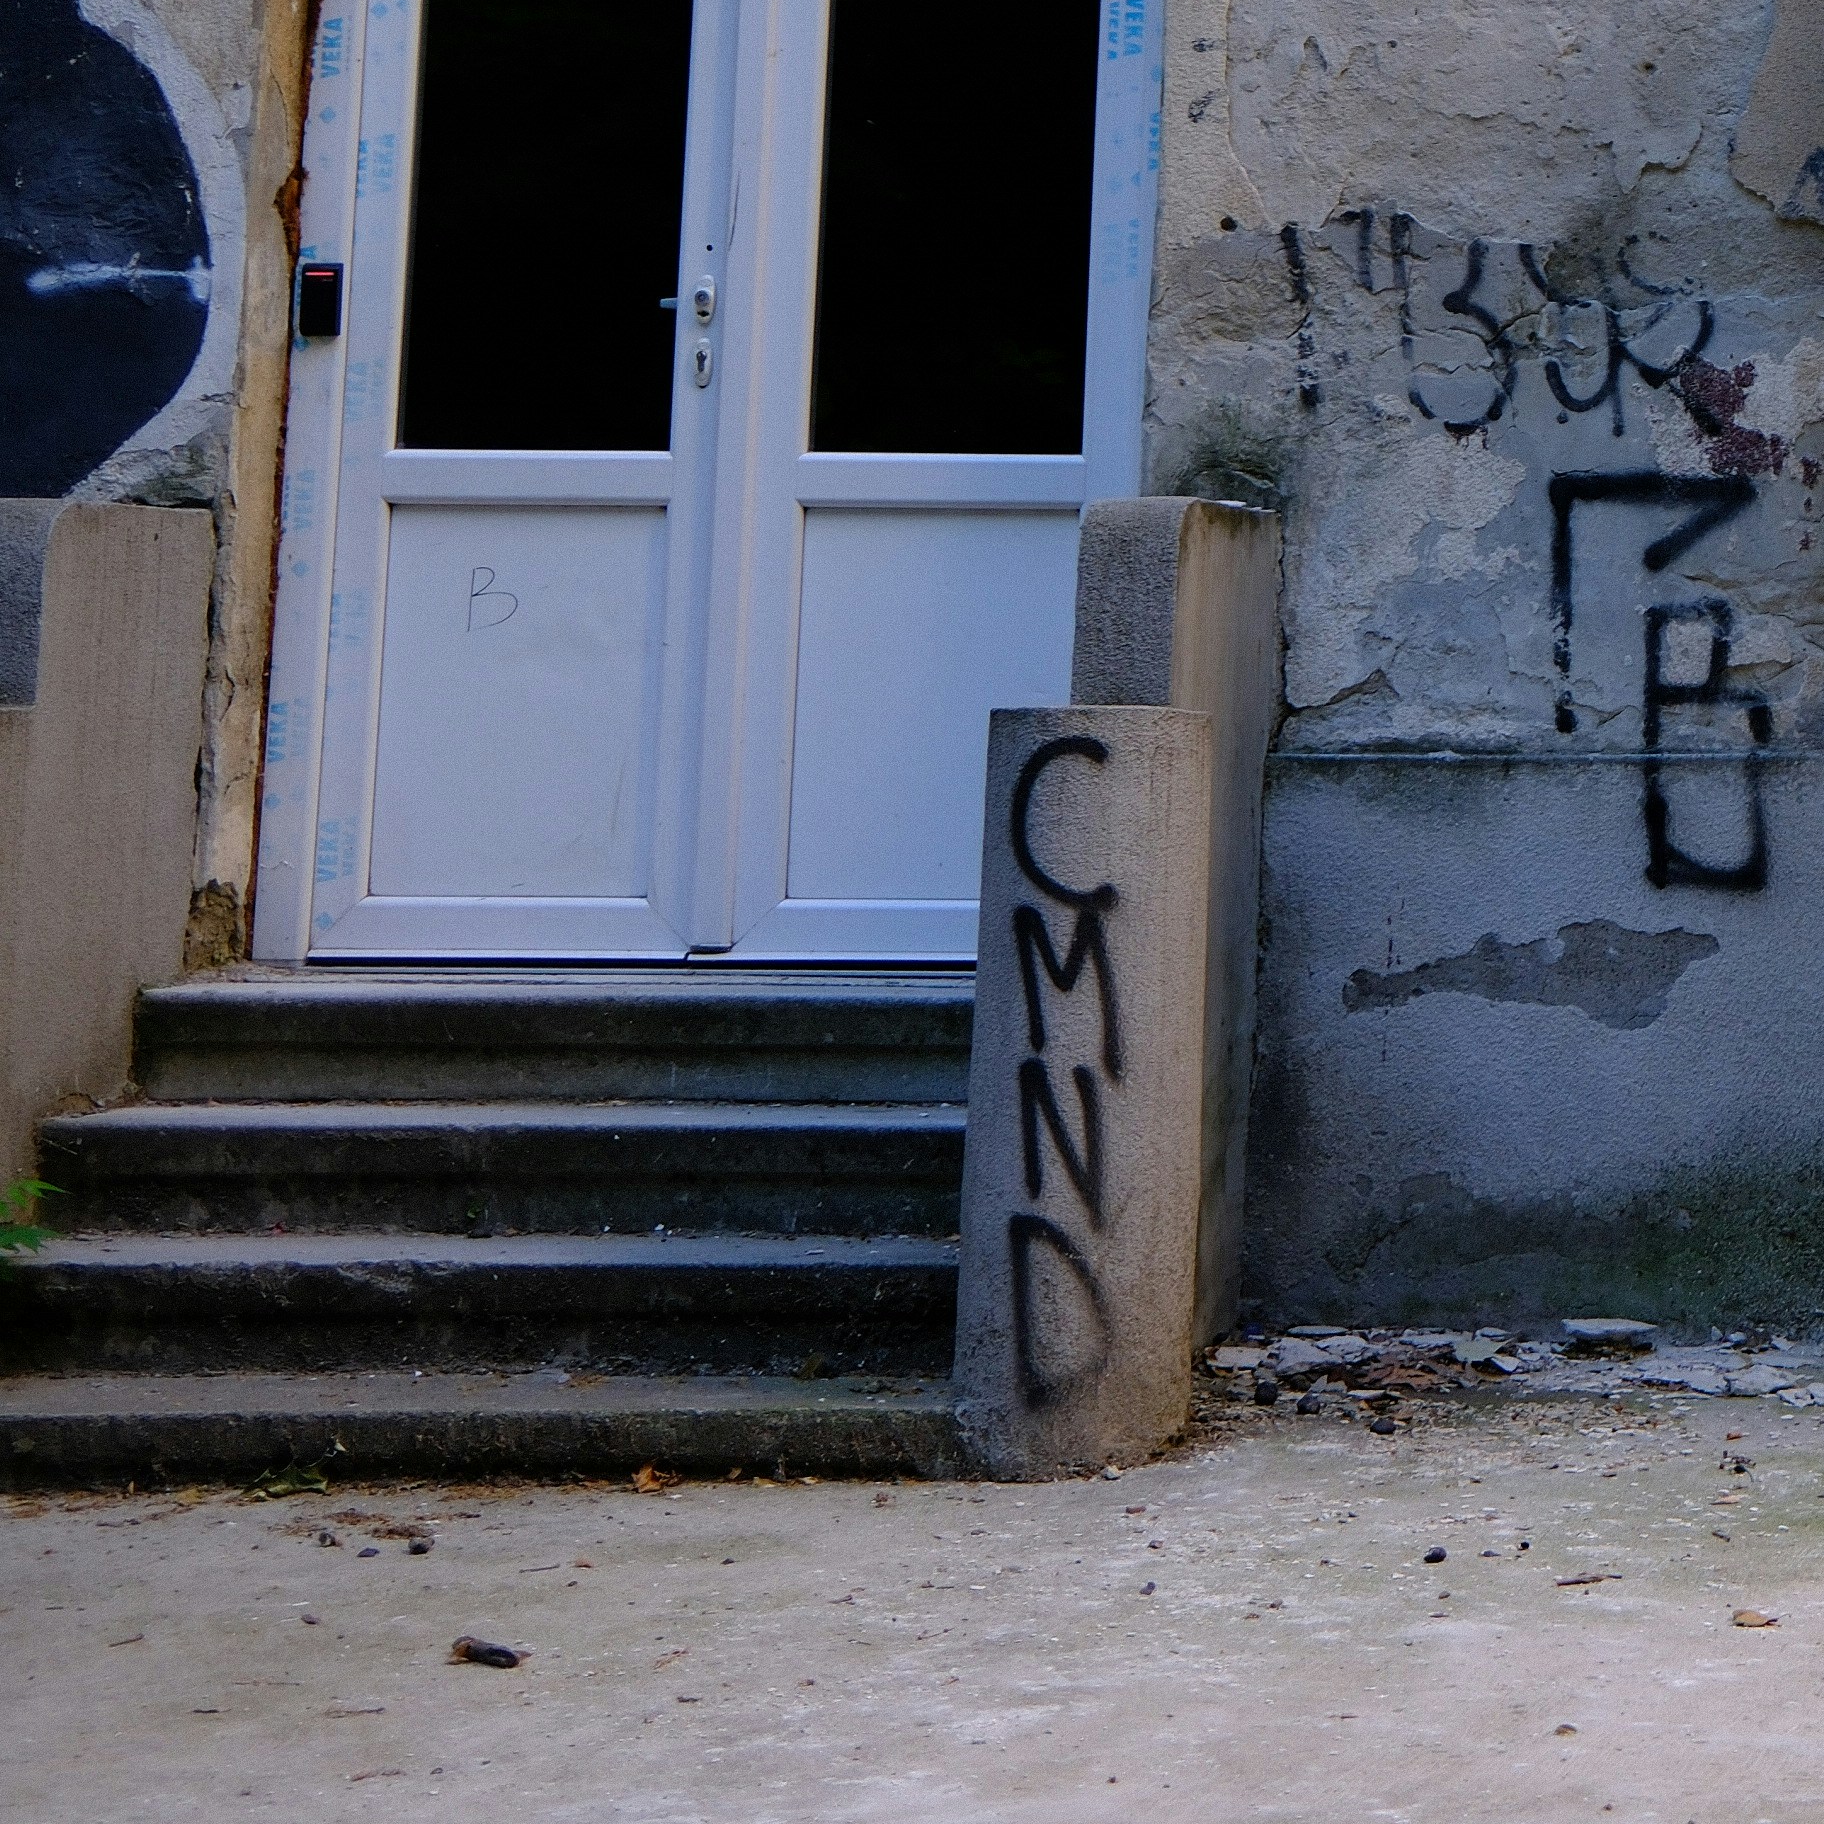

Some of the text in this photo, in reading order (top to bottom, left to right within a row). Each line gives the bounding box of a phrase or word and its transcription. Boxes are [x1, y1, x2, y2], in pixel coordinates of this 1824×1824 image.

[321, 17, 344, 78] VEKA
[467, 566, 520, 632] B
[267, 702, 288, 763] VEKA
[317, 818, 340, 883] VEKA
